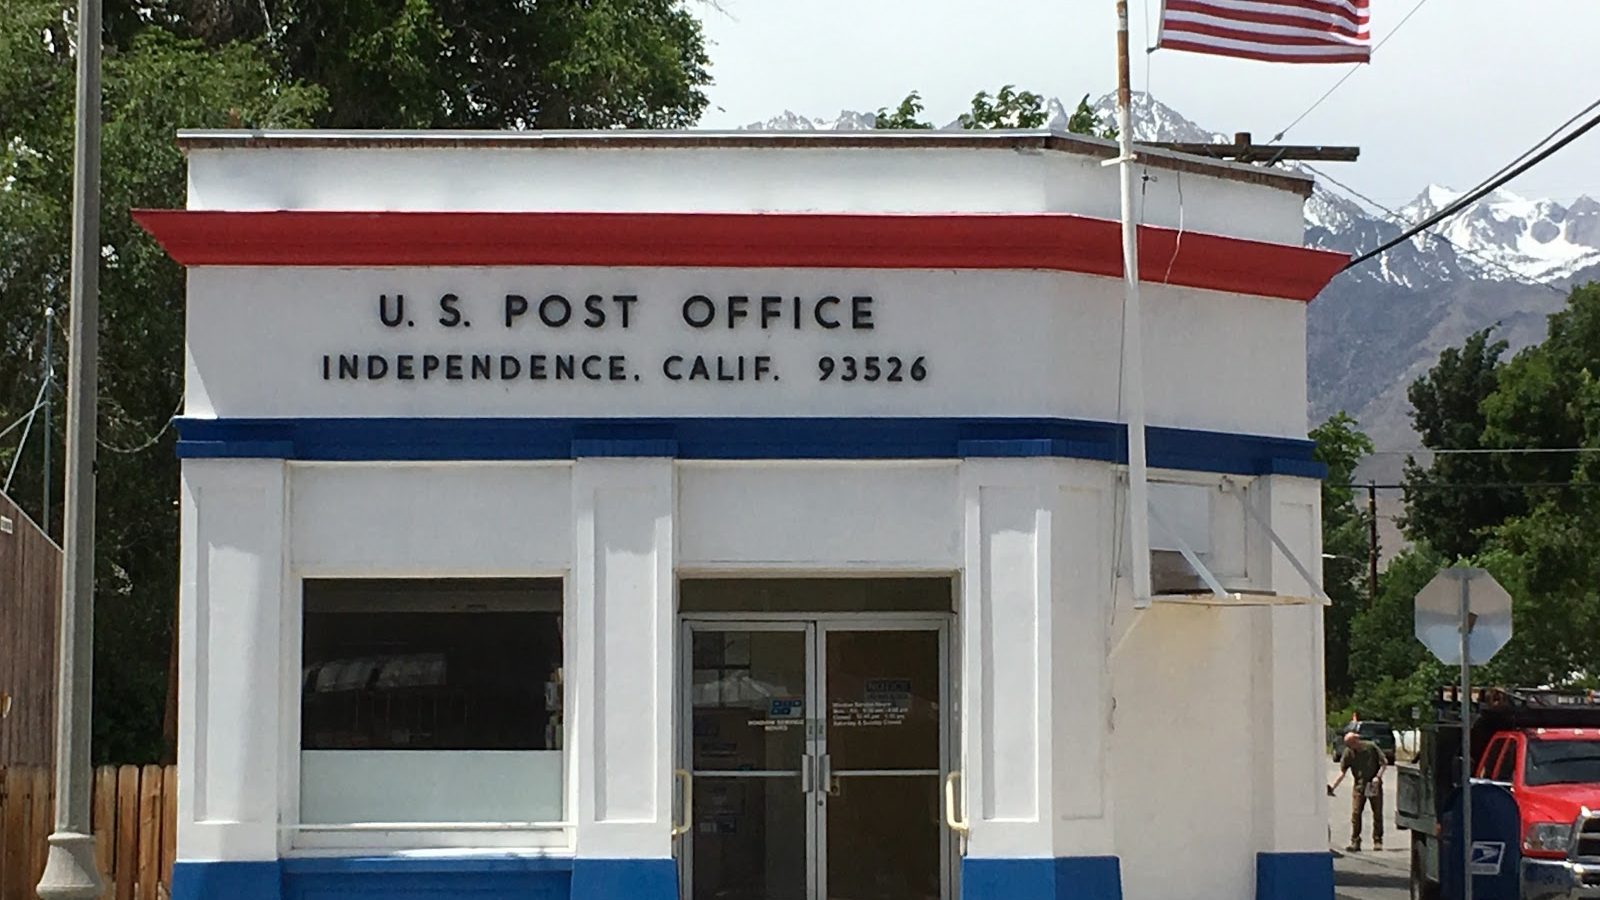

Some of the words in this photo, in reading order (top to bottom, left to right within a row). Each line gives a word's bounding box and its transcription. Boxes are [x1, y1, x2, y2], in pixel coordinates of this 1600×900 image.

[379, 294, 415, 329] U.
[438, 293, 471, 329] S.
[504, 294, 639, 329] POST
[682, 294, 875, 330] OFFICE
[662, 355, 780, 383] CALIF.
[818, 356, 928, 383] 93526
